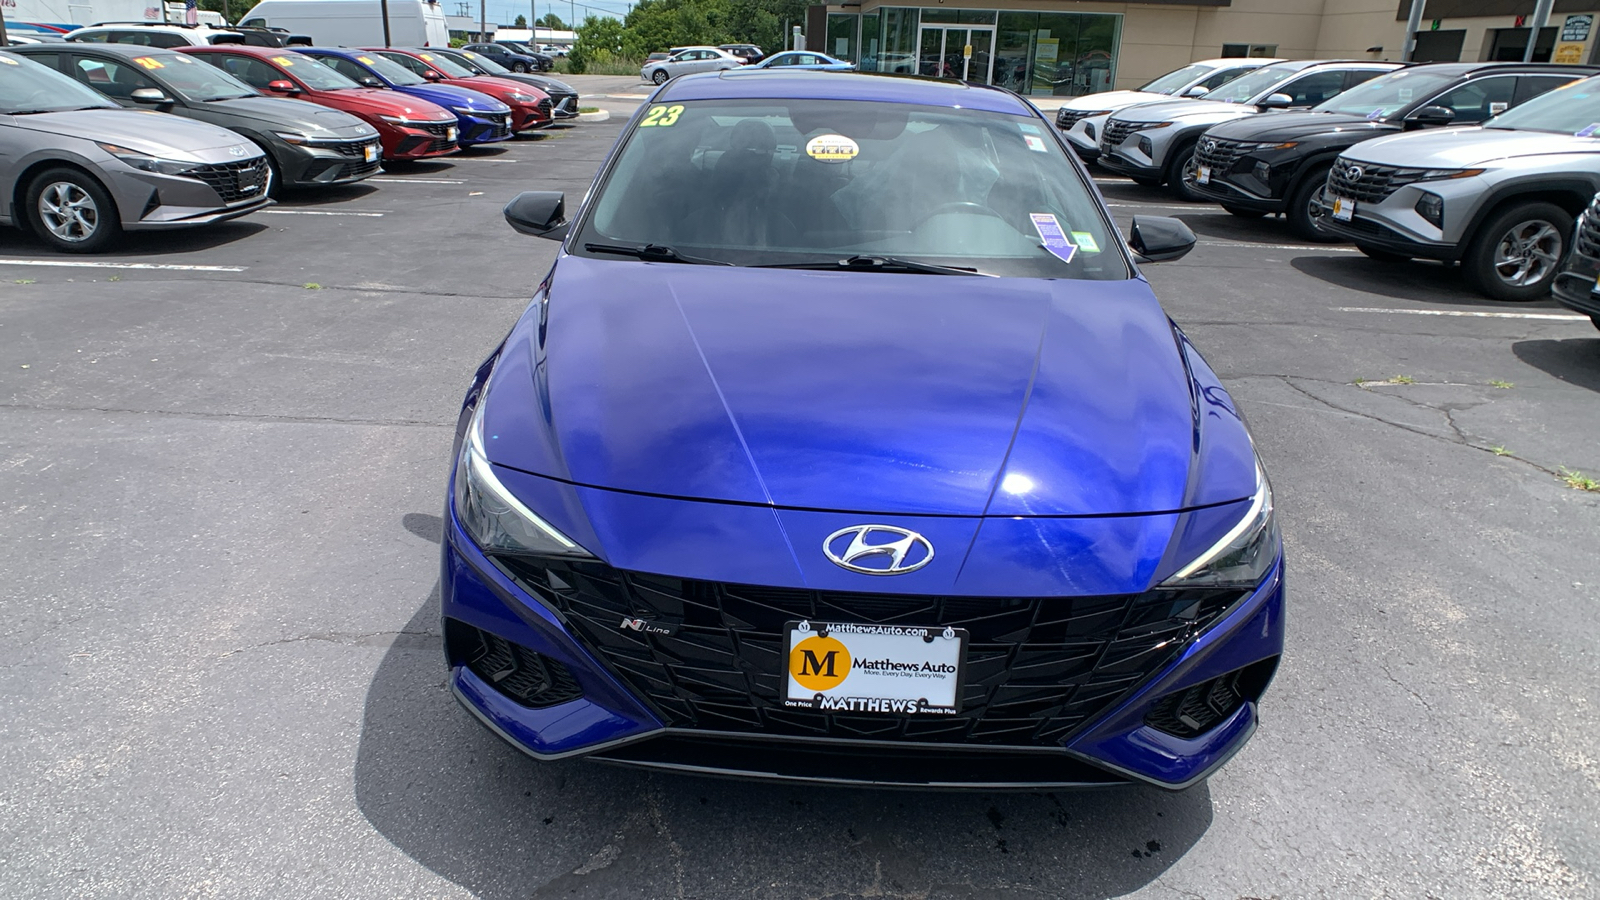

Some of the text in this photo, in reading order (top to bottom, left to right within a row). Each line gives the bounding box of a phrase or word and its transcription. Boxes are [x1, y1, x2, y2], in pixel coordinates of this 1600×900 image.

[639, 105, 685, 127] 23
[645, 625, 670, 635] Line
[825, 623, 928, 637] MatthewsAuto.com
[798, 649, 840, 677] M
[852, 657, 956, 673] Matthews Auto
[820, 697, 918, 714] MATTHEWS
